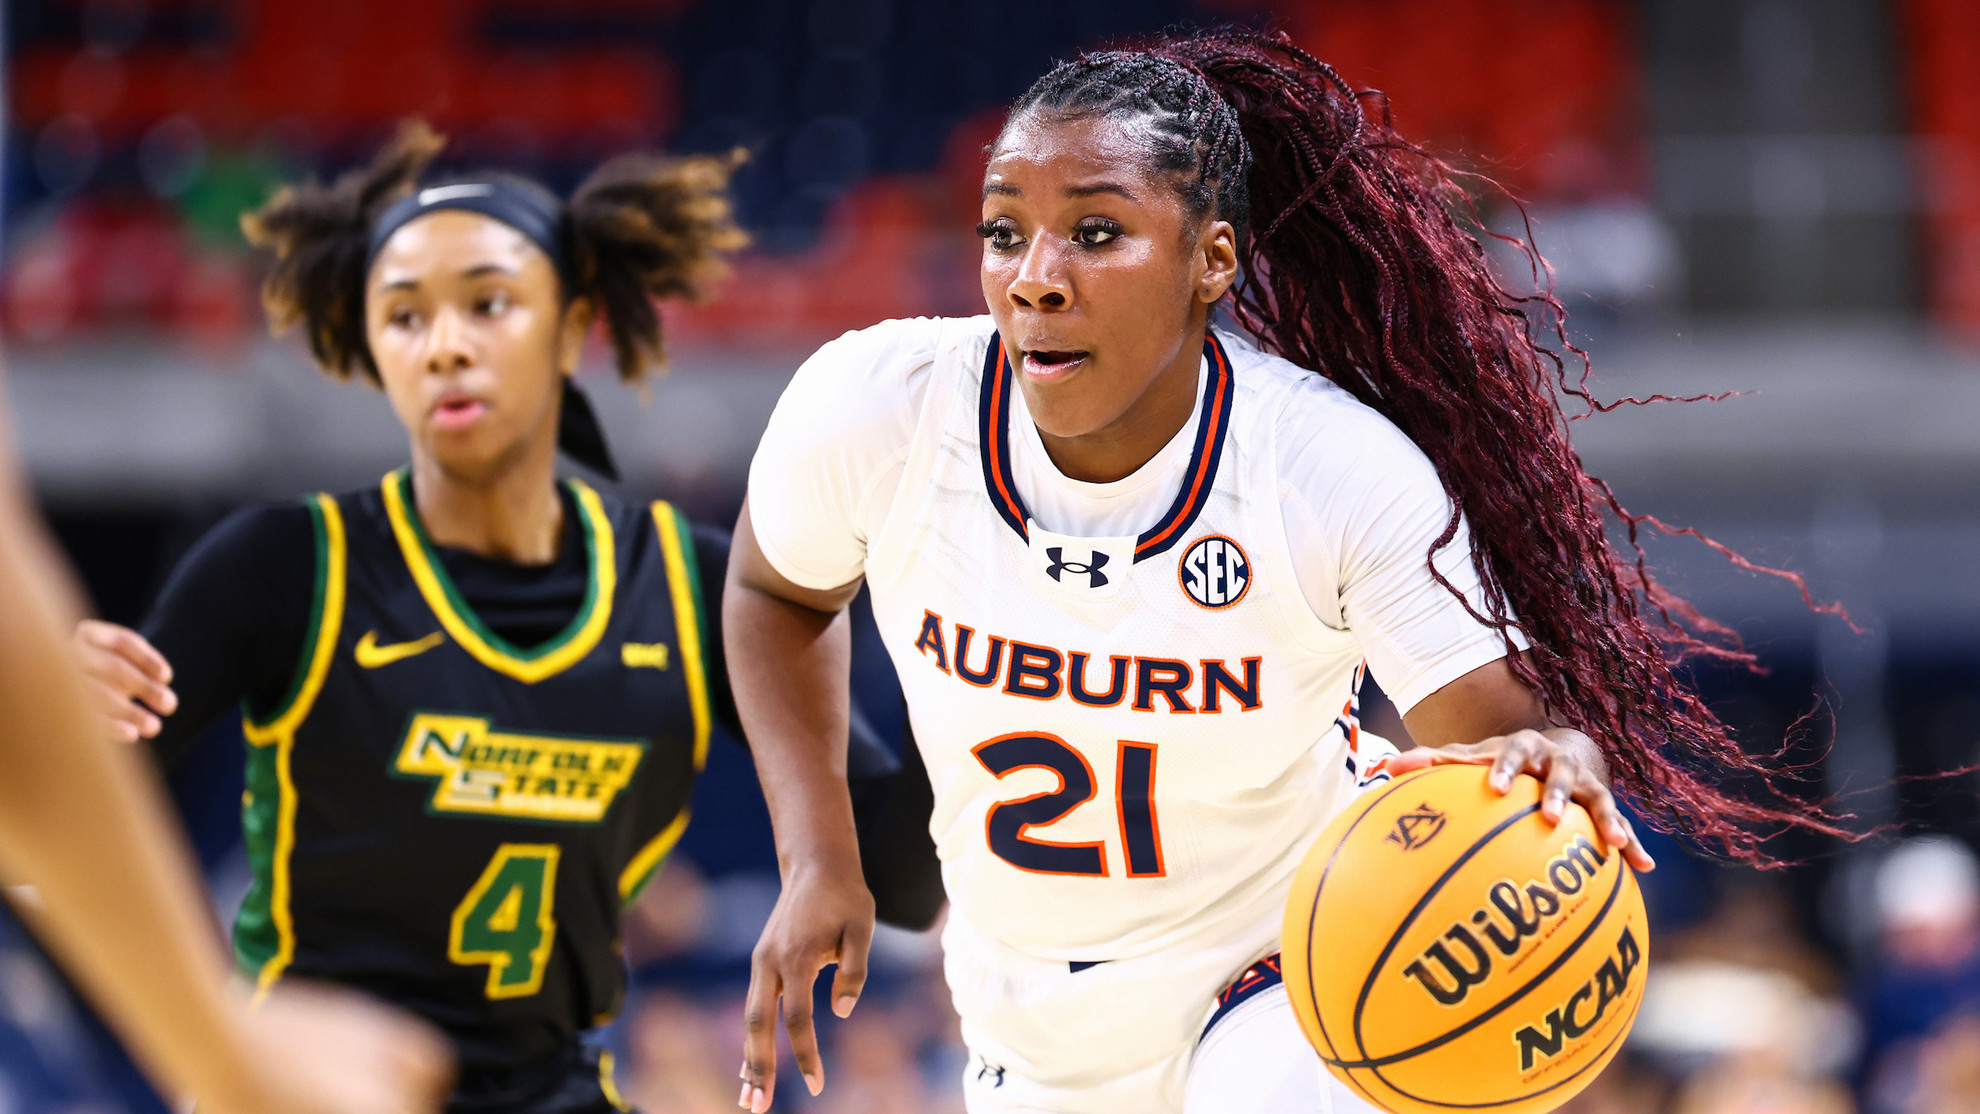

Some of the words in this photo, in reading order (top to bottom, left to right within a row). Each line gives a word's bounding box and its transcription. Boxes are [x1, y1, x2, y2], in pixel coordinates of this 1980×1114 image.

[1184, 539, 1247, 605] SEC
[915, 608, 1263, 714] AUBURN
[408, 727, 626, 773] NORFOLK
[449, 767, 602, 806] STATE
[970, 731, 1167, 878] 21
[448, 843, 561, 999] 4
[1402, 834, 1607, 1006] Wilson
[1514, 926, 1641, 1071] NCAA
